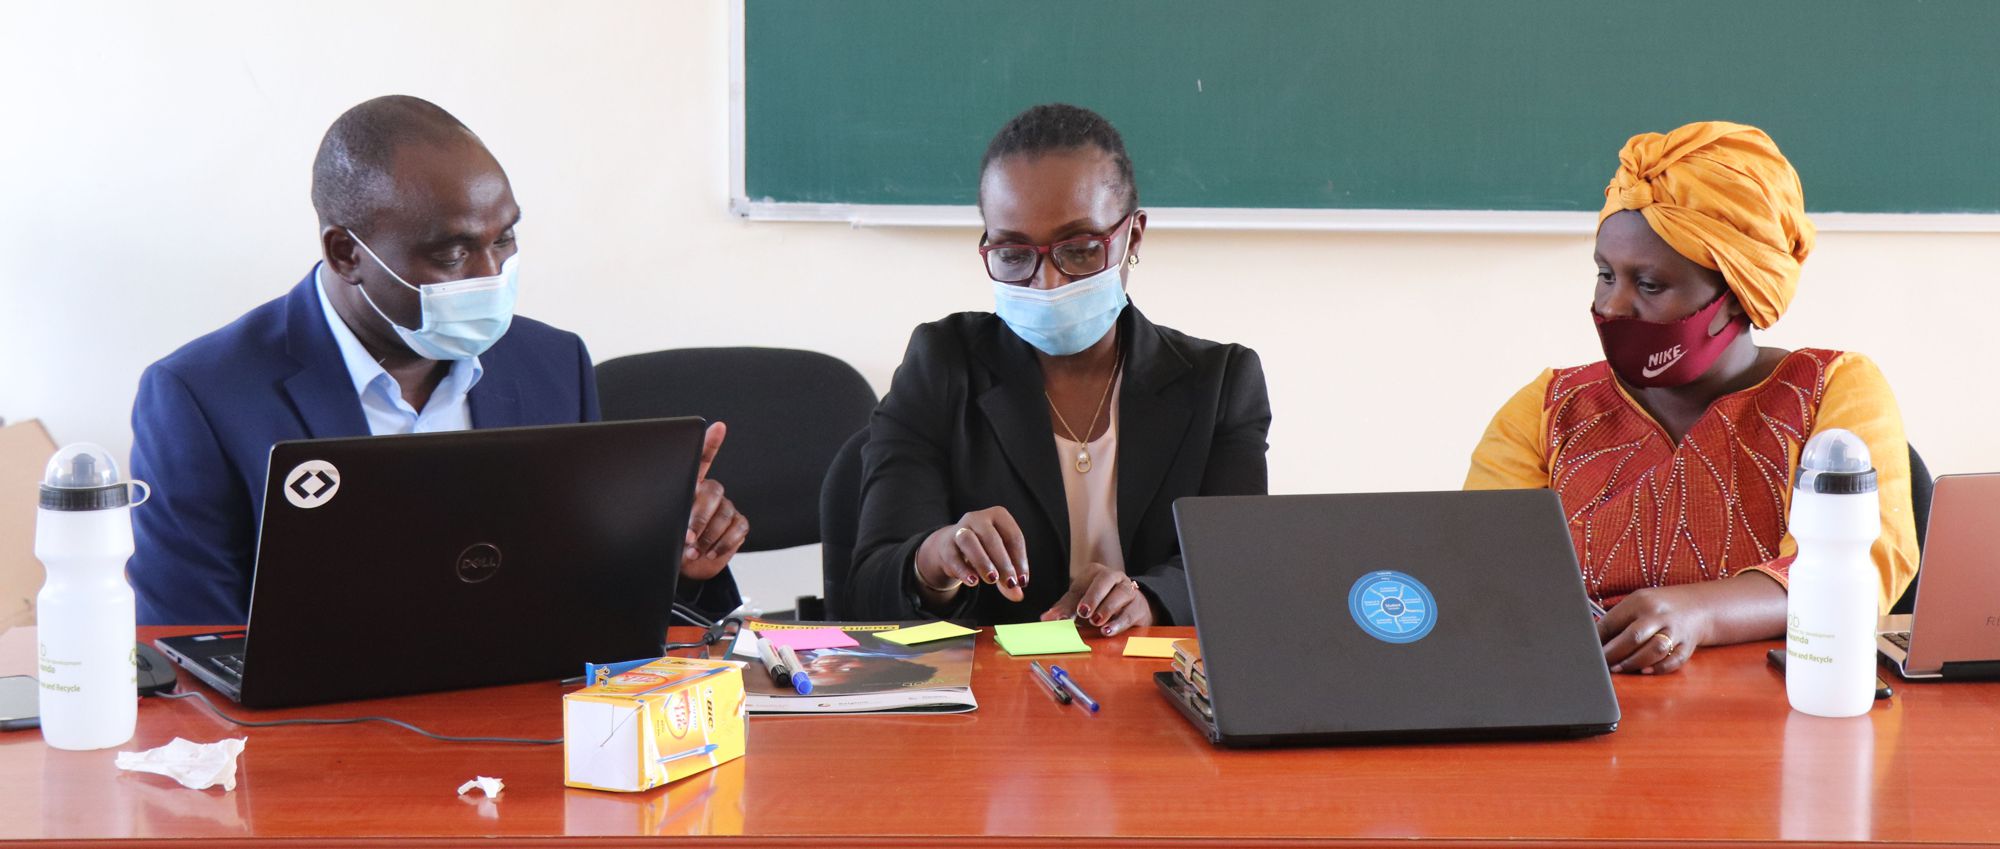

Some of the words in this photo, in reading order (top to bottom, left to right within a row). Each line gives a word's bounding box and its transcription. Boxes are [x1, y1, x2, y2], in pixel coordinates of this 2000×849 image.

[1648, 344, 1681, 367] NIKE
[462, 556, 497, 569] DELL
[1808, 653, 1833, 664] Recycle
[56, 683, 81, 693] Recycle
